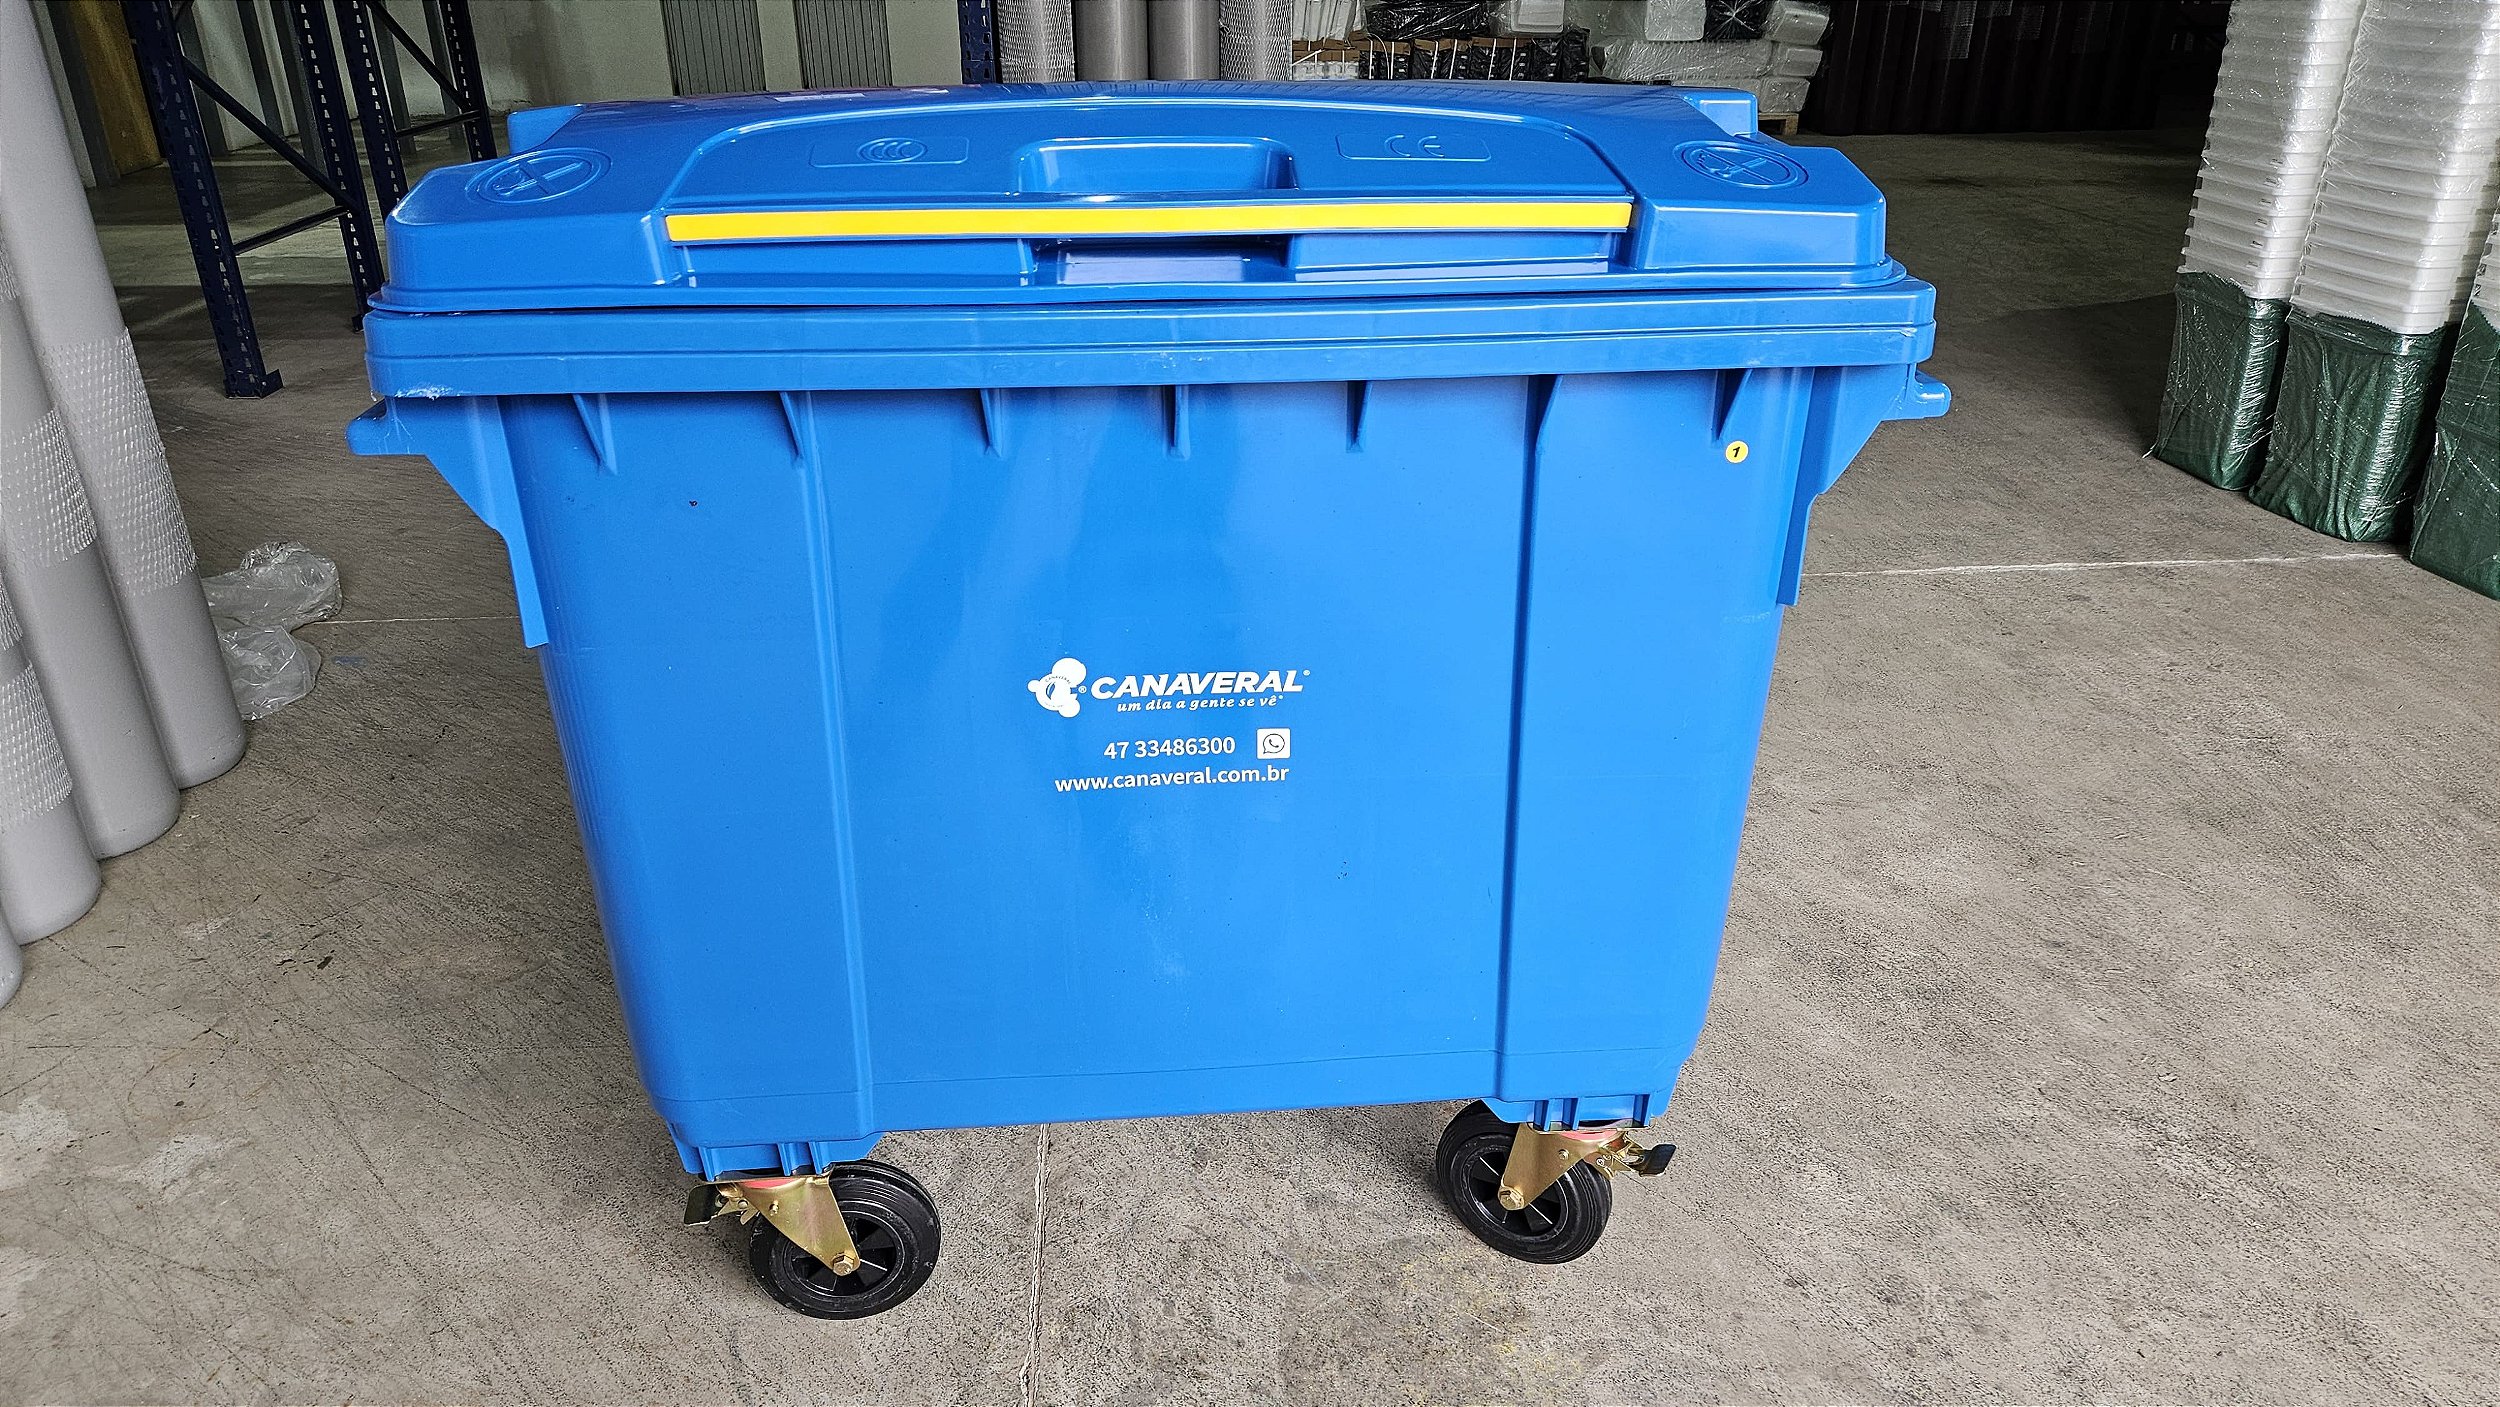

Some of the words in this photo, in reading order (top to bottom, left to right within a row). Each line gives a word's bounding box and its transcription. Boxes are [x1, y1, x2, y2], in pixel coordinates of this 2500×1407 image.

[1117, 702, 1142, 712] um
[1145, 698, 1173, 711] dia
[1175, 701, 1187, 709] a
[1189, 698, 1235, 712] gente
[1238, 698, 1256, 708] se
[1103, 741, 1129, 759] 47
[1134, 737, 1236, 758] 33486300
[1054, 765, 1290, 792] www.canaveral.com.br
